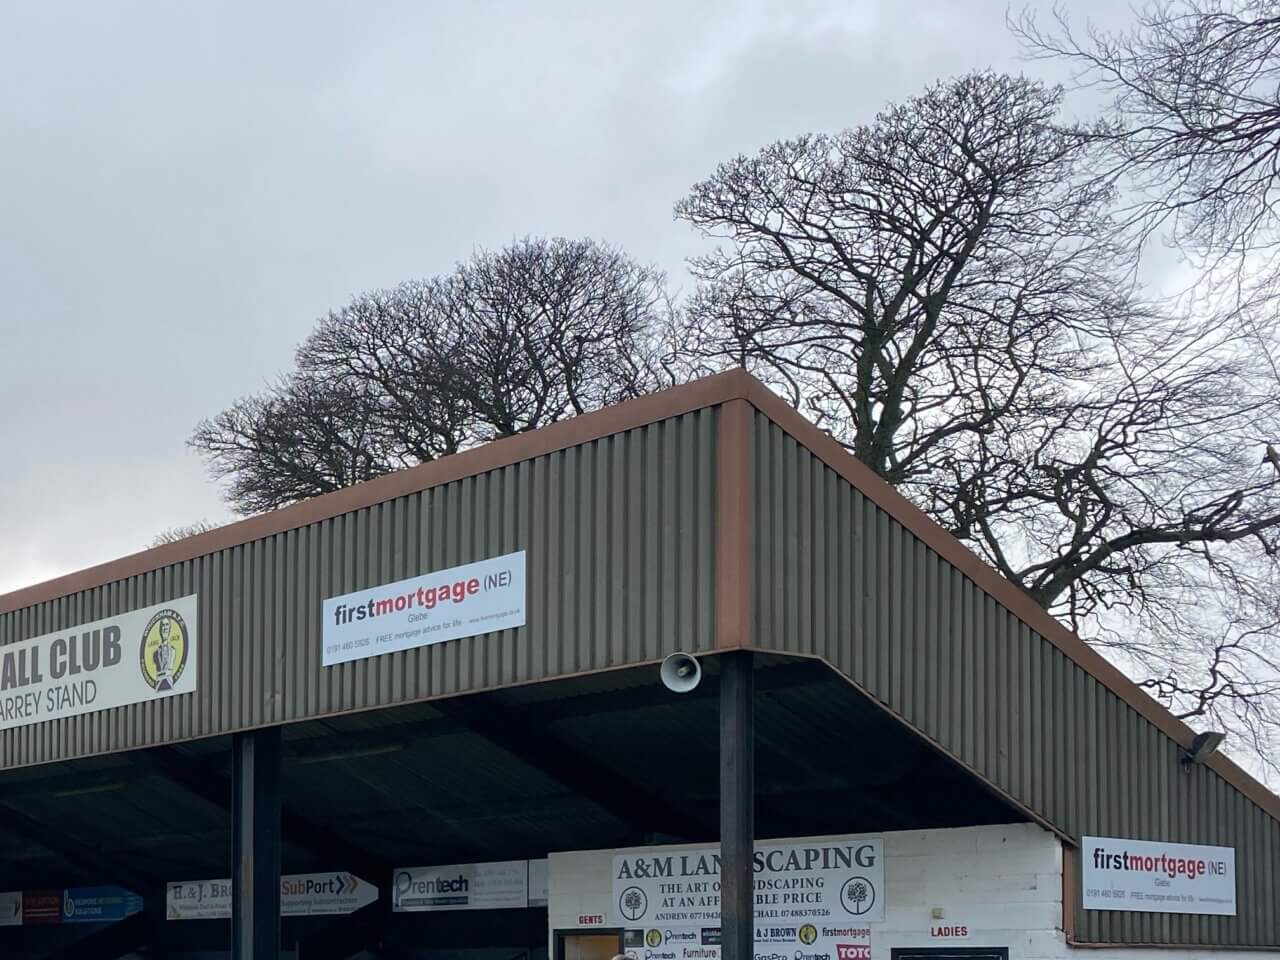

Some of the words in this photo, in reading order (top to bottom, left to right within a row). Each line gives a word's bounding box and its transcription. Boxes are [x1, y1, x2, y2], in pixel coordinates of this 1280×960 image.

[333, 577, 480, 626] firstmortgage
[483, 570, 512, 593] (NE)
[394, 627, 421, 641] mortgage
[49, 625, 122, 680] CLUB
[46, 679, 97, 713] STAND
[617, 856, 674, 880] A&M
[1093, 847, 1206, 880] firstmortgage
[1207, 860, 1227, 876] (NE)
[281, 875, 337, 896] SubPort
[658, 883, 683, 894] THE
[686, 881, 709, 893] ART
[661, 897, 676, 908] AT
[678, 896, 695, 908] AN
[782, 891, 823, 904] PRICE
[578, 914, 604, 925] GENTS
[654, 912, 690, 921] ANDREW
[770, 927, 797, 938] BROWN
[822, 927, 871, 939] firstmortgage
[930, 925, 969, 938] LADIES
